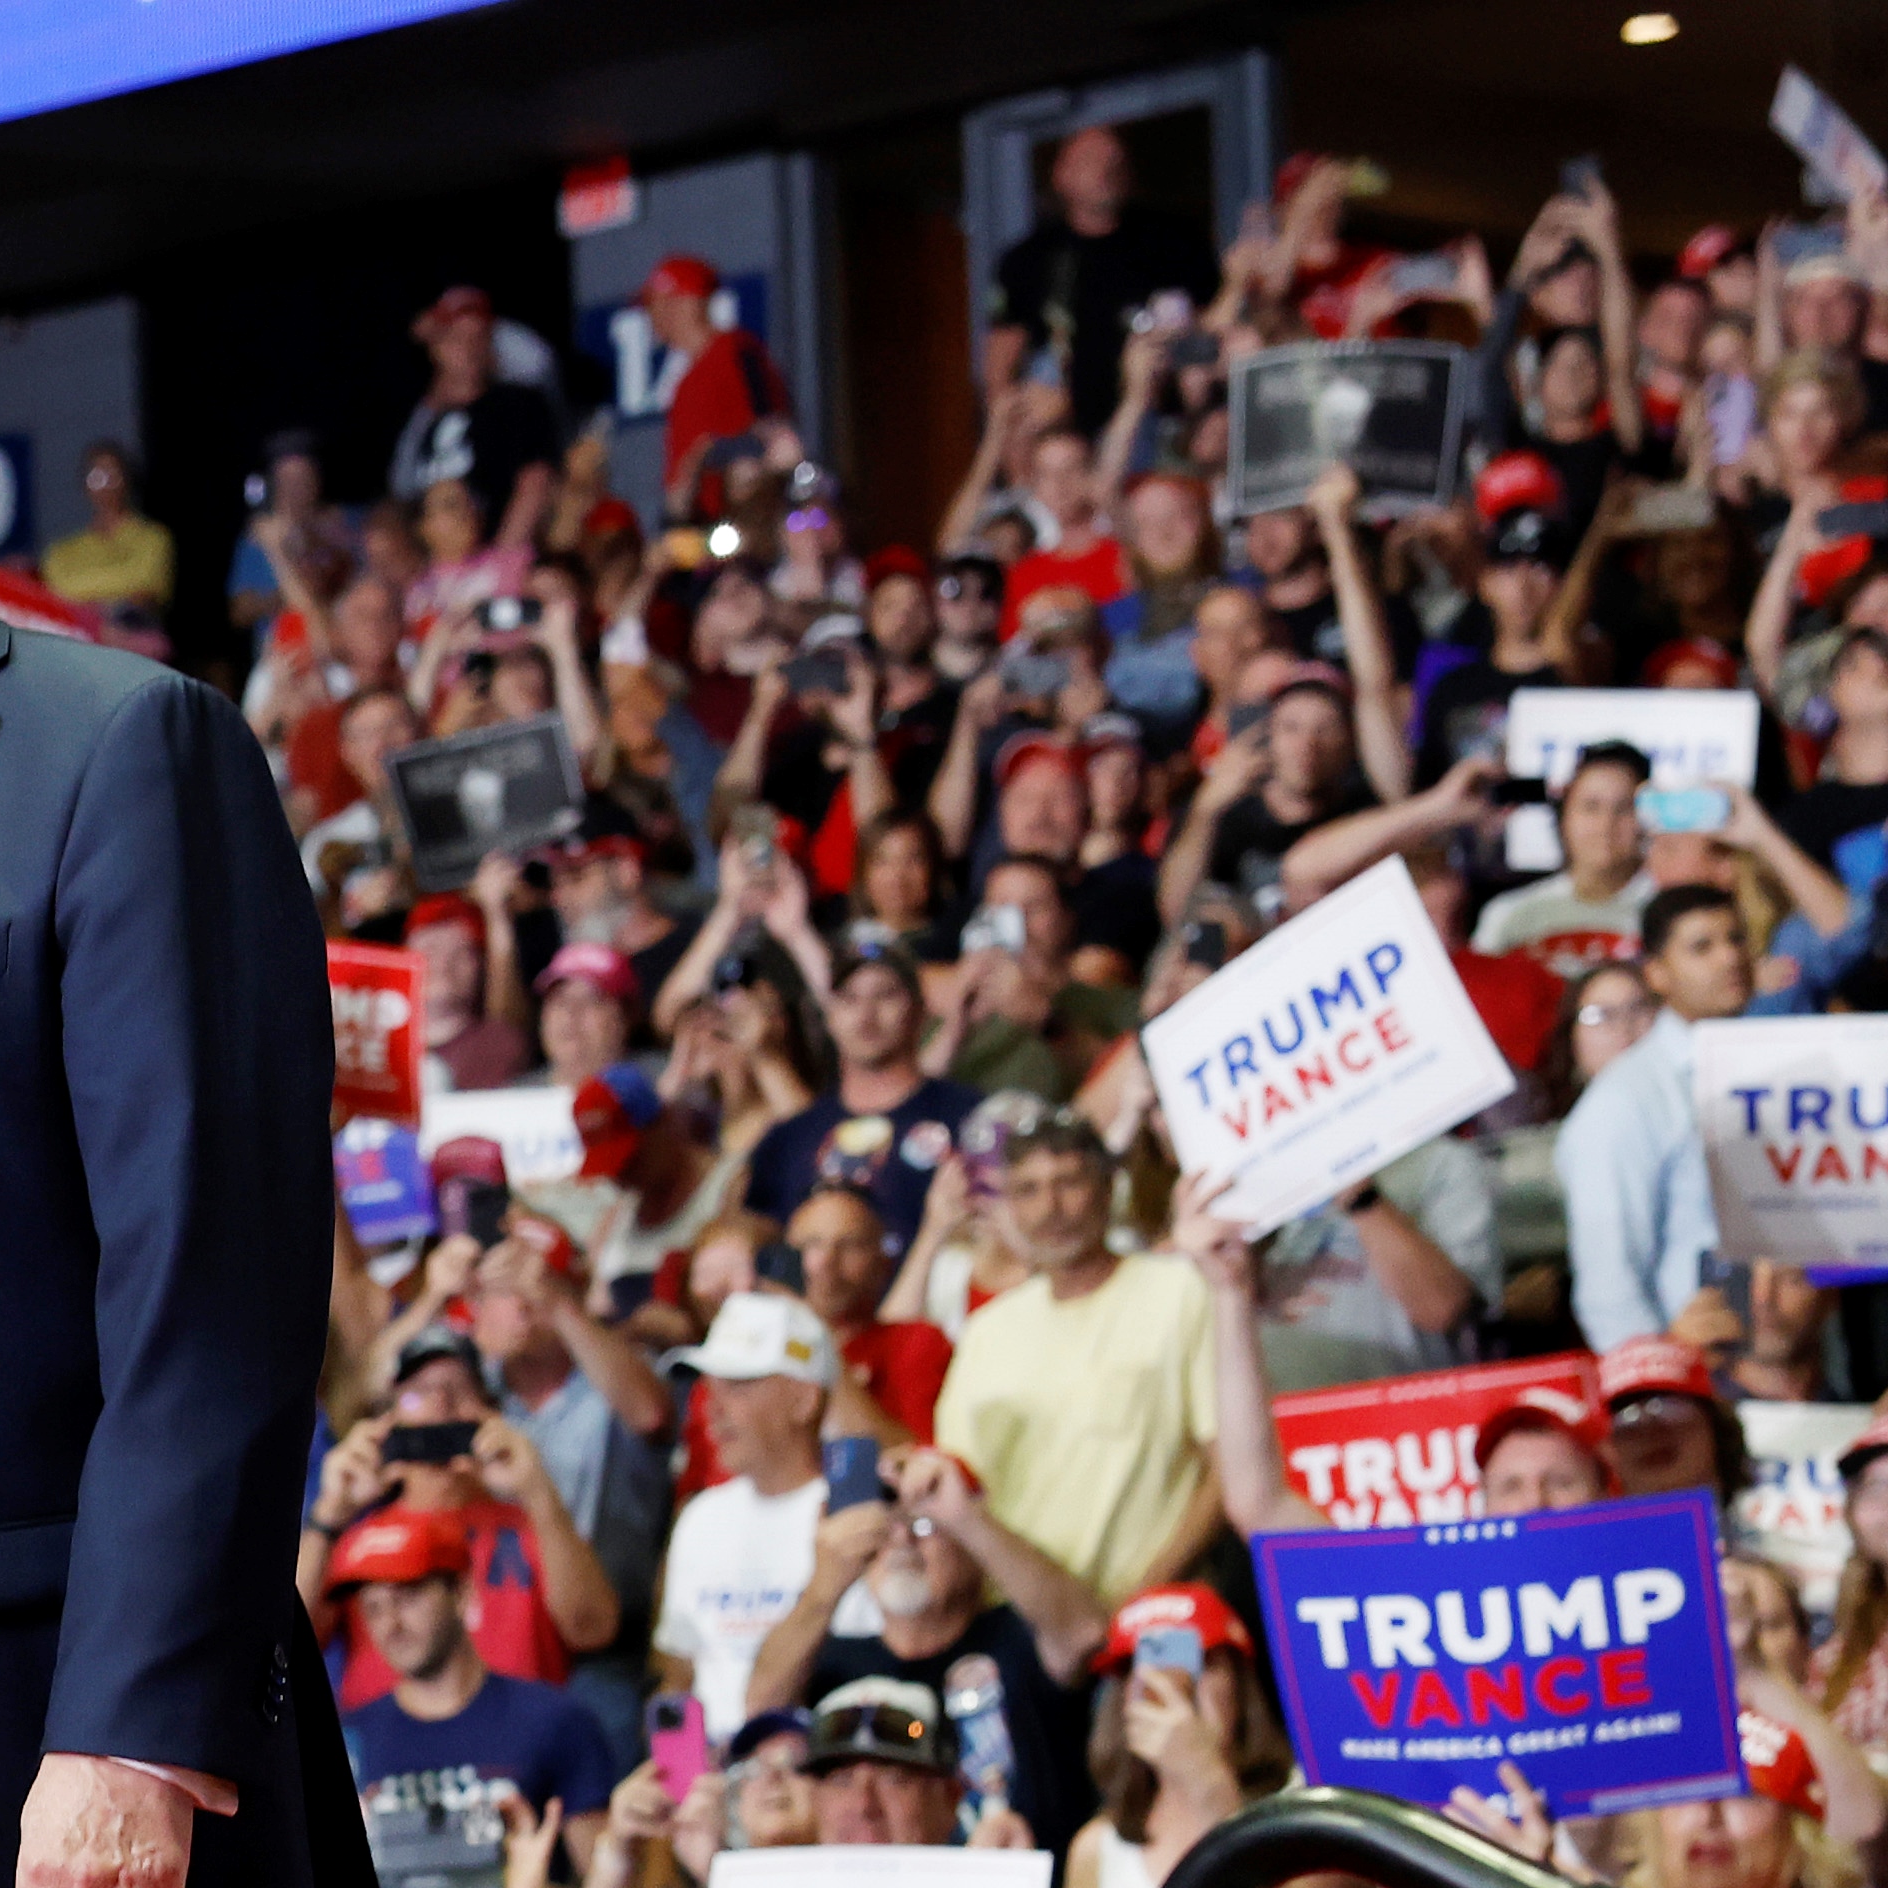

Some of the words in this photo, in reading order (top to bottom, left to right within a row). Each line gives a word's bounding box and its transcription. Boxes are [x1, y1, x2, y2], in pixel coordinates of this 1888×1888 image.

[1185, 942, 1403, 1108] TRUMP
[1221, 1006, 1410, 1141] VANCE
[1289, 1424, 1480, 1506] TRU
[1297, 1567, 1686, 1669] TRUMP
[1348, 1647, 1653, 1730] VANCE
